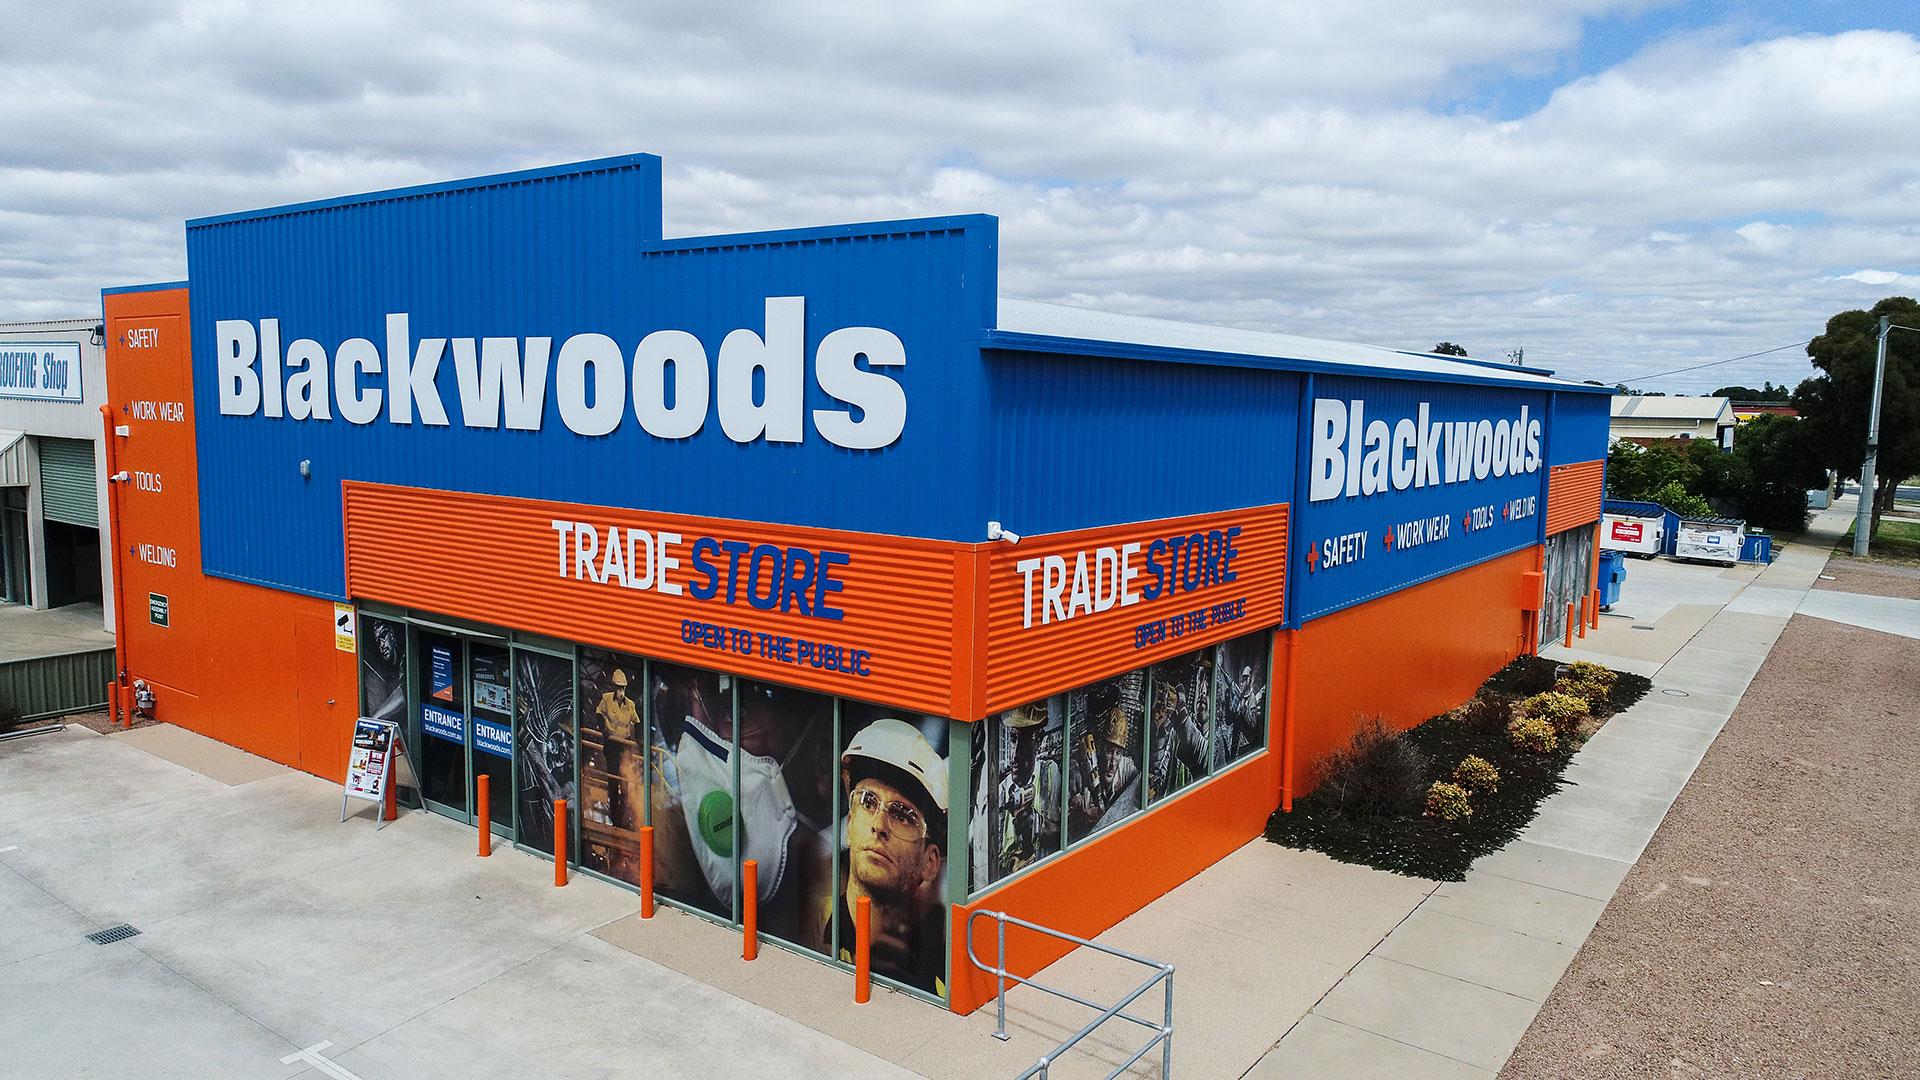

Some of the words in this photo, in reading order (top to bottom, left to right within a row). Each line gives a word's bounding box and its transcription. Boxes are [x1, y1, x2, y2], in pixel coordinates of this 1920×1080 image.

[128, 328, 159, 348] SAFETY
[42, 352, 68, 396] Shop
[216, 295, 907, 450] Blackwoods
[132, 400, 158, 421] WORK
[159, 402, 185, 422] WEAR
[1310, 398, 1543, 502] Blackwoods
[135, 471, 162, 493] TOOLS
[139, 542, 177, 568] WELDING
[1322, 530, 1368, 569] SAFETY
[1397, 520, 1425, 550] WORK
[1426, 514, 1450, 544] WEAR
[1472, 504, 1494, 532] TOOLS
[1509, 496, 1536, 521] WELDING
[552, 519, 684, 596] TRADE
[688, 537, 850, 621] STORE
[1016, 542, 1141, 630] TRADE
[1144, 526, 1242, 600] STORE
[1135, 618, 1167, 649] OPEN
[1169, 613, 1185, 638] TO
[1188, 606, 1209, 632] THE
[1211, 597, 1247, 627] PUBLIC
[681, 619, 726, 650] OPEN
[728, 626, 752, 654] TO
[757, 632, 793, 663] THE
[797, 638, 871, 677] PUBLIC
[424, 708, 462, 731] ENTRANCE
[424, 723, 463, 741] blackwoods.com.au
